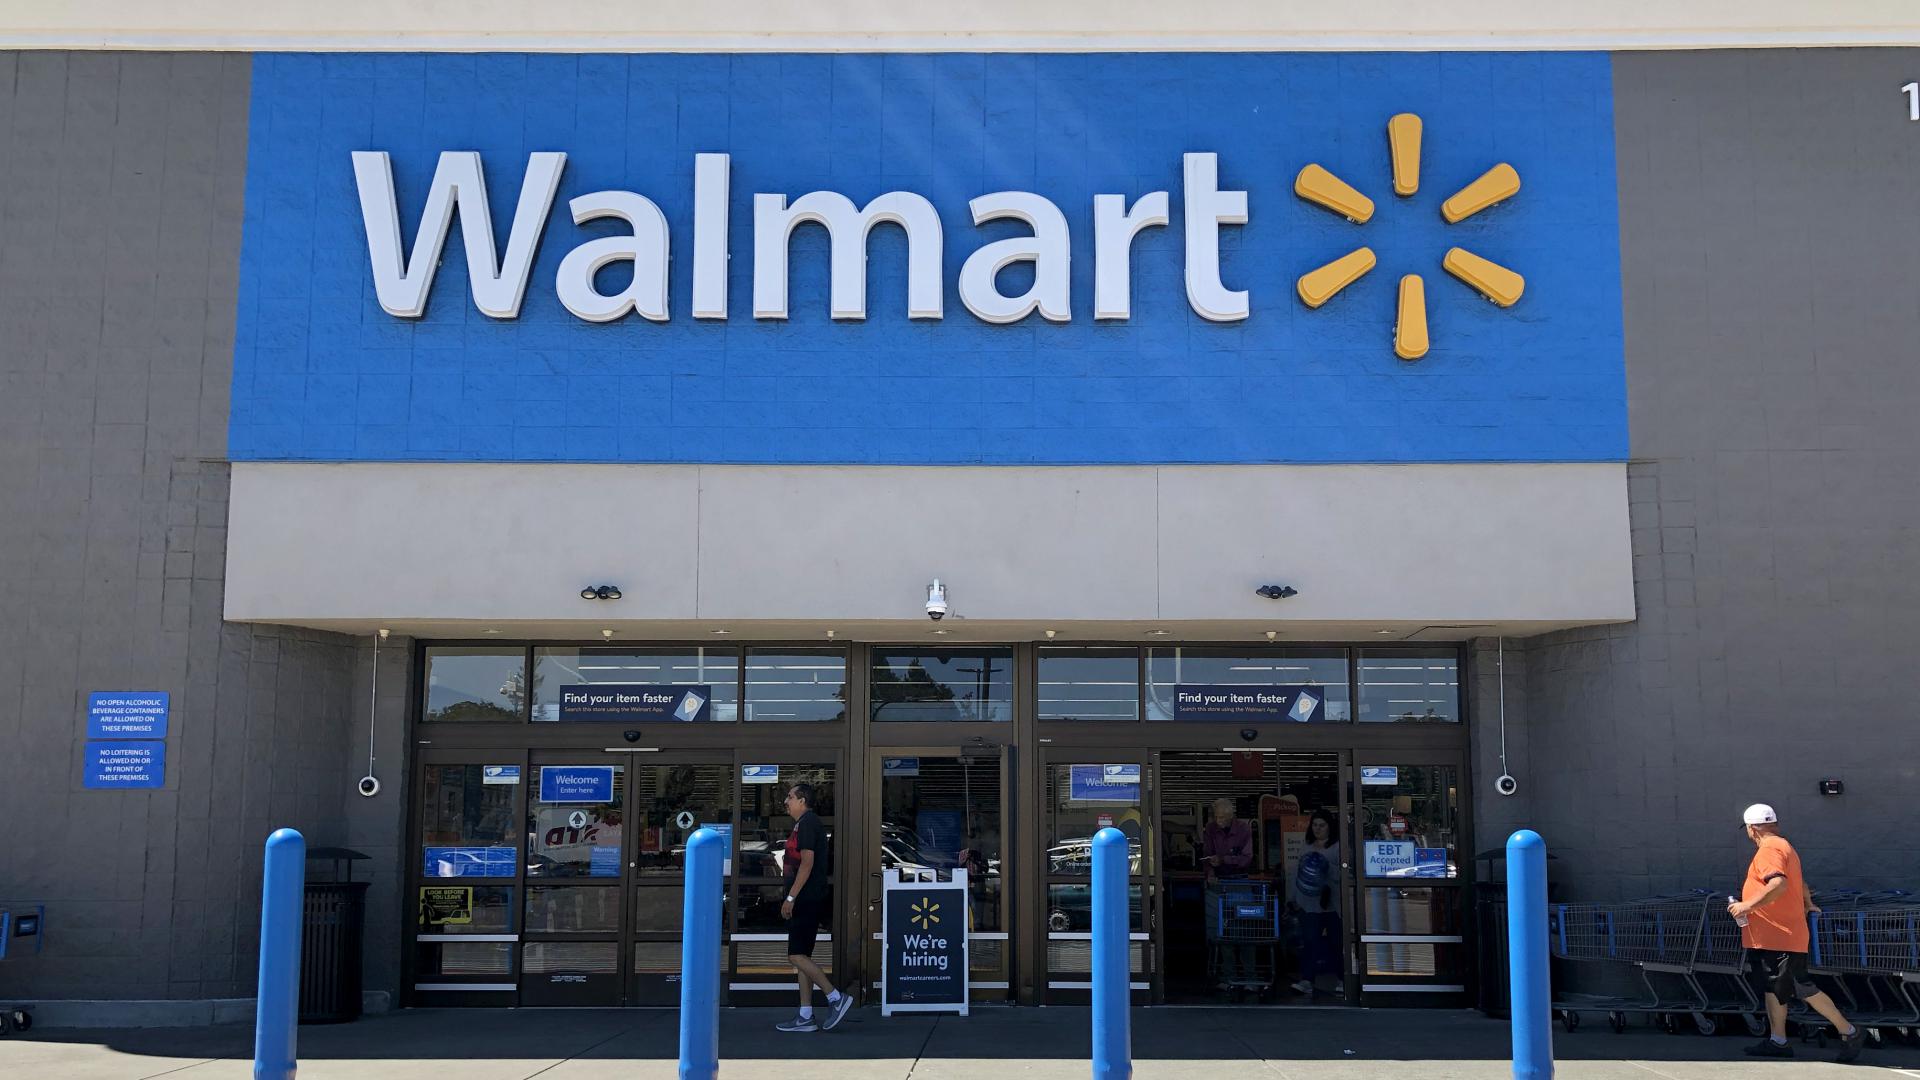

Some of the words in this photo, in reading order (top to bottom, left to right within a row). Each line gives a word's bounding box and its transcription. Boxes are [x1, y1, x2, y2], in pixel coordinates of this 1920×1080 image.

[351, 150, 1250, 324] Walmart
[564, 693, 588, 703] Find
[591, 695, 614, 706] your
[616, 693, 640, 703] item
[643, 693, 674, 703] faster
[1178, 693, 1202, 703] Find
[1204, 695, 1228, 706] your
[1230, 693, 1254, 703] item
[1256, 693, 1287, 703] faster
[555, 774, 599, 784] Welcome
[1378, 845, 1402, 855] EBT
[1370, 855, 1411, 864] Accepted
[904, 934, 947, 949] We're
[903, 951, 948, 970] hiring
